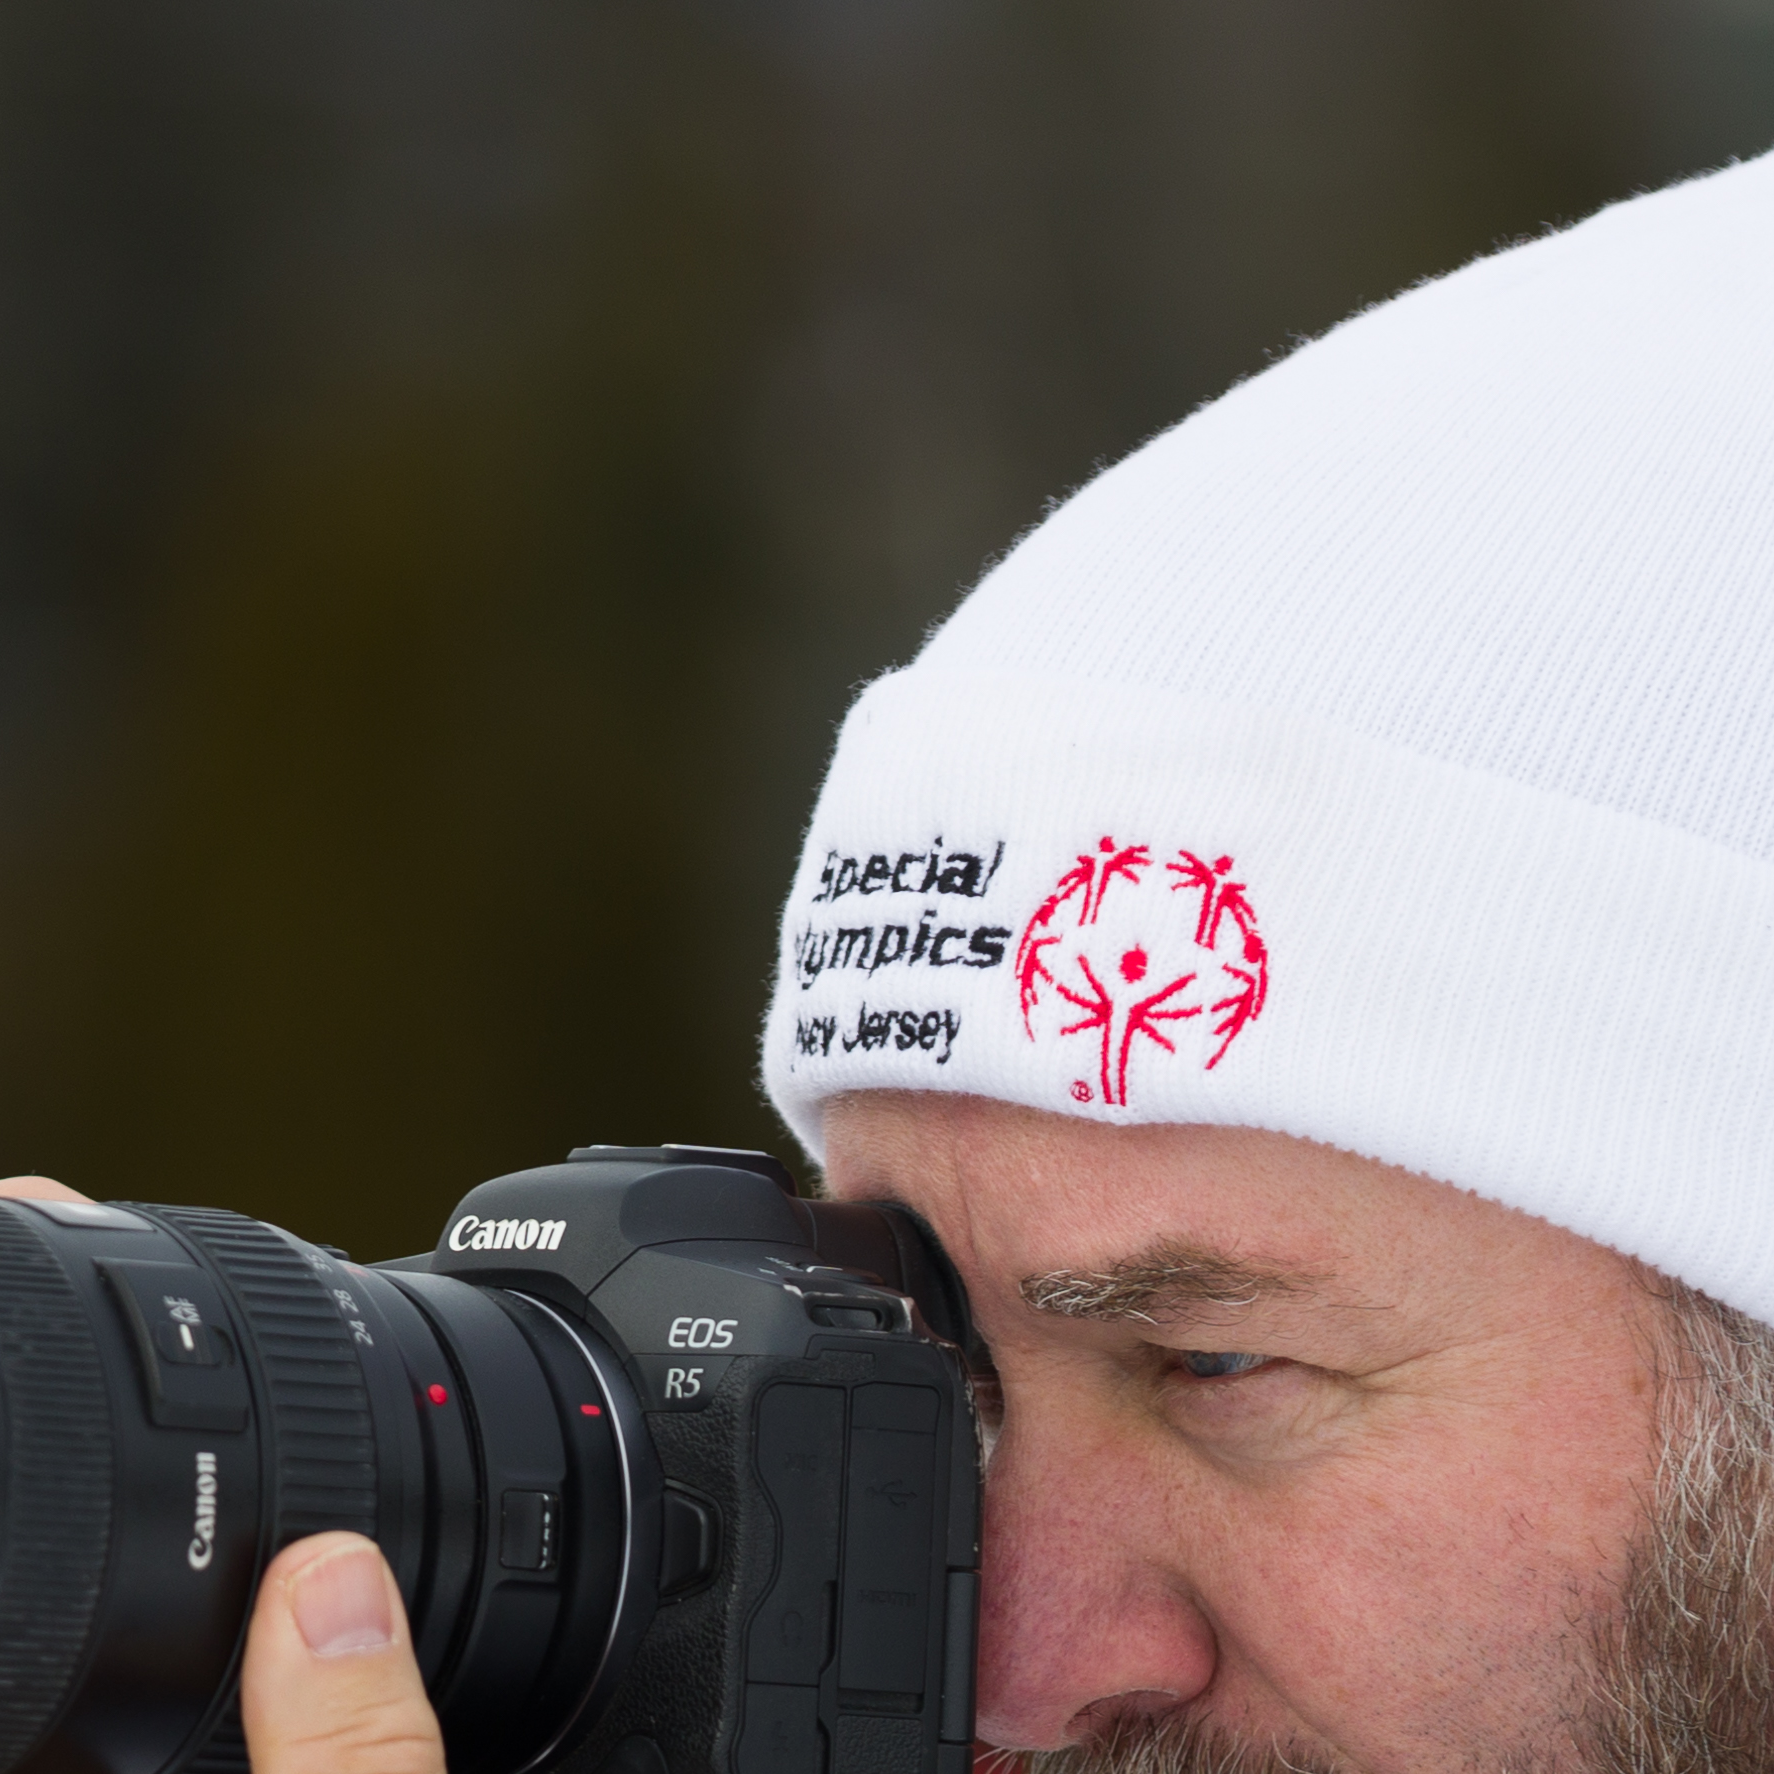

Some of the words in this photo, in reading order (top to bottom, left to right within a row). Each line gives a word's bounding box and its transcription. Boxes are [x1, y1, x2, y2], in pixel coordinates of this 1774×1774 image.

[843, 1001, 961, 1065] Jersey
[448, 1214, 567, 1252] Canon
[304, 1252, 333, 1273] 35
[163, 1295, 187, 1320] AF
[177, 1296, 201, 1324] MF
[332, 1288, 359, 1313] 28
[348, 1319, 374, 1346] 24
[668, 1316, 739, 1349] EOS
[665, 1367, 704, 1399] R5
[187, 1451, 217, 1571] Canon
[858, 1589, 917, 1608] HDMI
